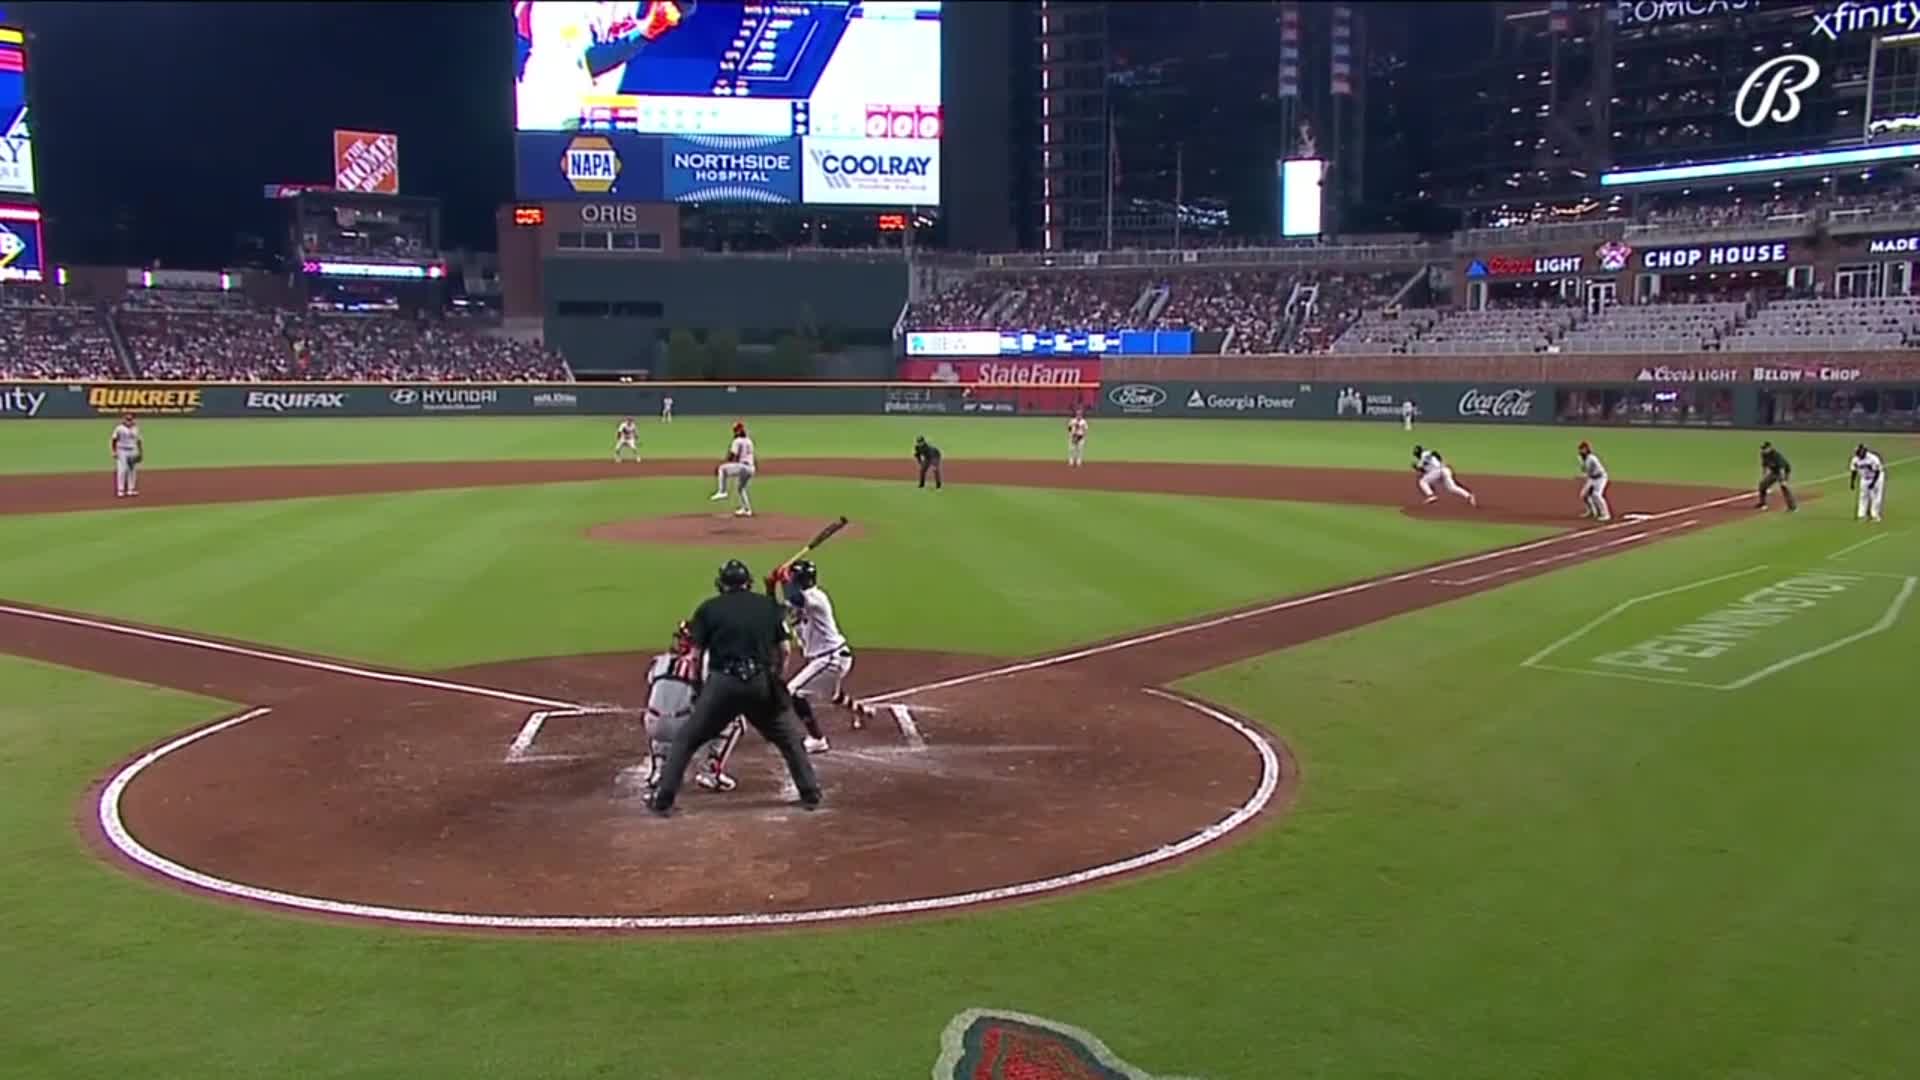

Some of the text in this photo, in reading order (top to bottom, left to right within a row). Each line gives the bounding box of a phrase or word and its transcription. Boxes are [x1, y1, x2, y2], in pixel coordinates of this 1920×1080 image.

[1618, 0, 1761, 25] OMCA
[1810, 0, 1920, 40] xfinity
[337, 134, 397, 191] HOME
[571, 153, 613, 177] NAPA
[674, 154, 791, 170] NORTHSIDE
[822, 155, 932, 176] COOLRAY
[695, 170, 769, 182] HOSPITAL
[581, 204, 637, 222] ORIS
[1870, 237, 1919, 253] MADE
[1535, 257, 1582, 273] LIGHT
[1644, 244, 1787, 268] CHOP HOUSE
[1698, 368, 1738, 382] LIGHT
[1753, 367, 1861, 382] BELOW CHOP
[88, 387, 204, 407] QUIKRETE
[247, 391, 344, 411] EQUIFAX
[423, 389, 497, 403] HYUNDAI
[1207, 394, 1296, 411] Georgia Power
